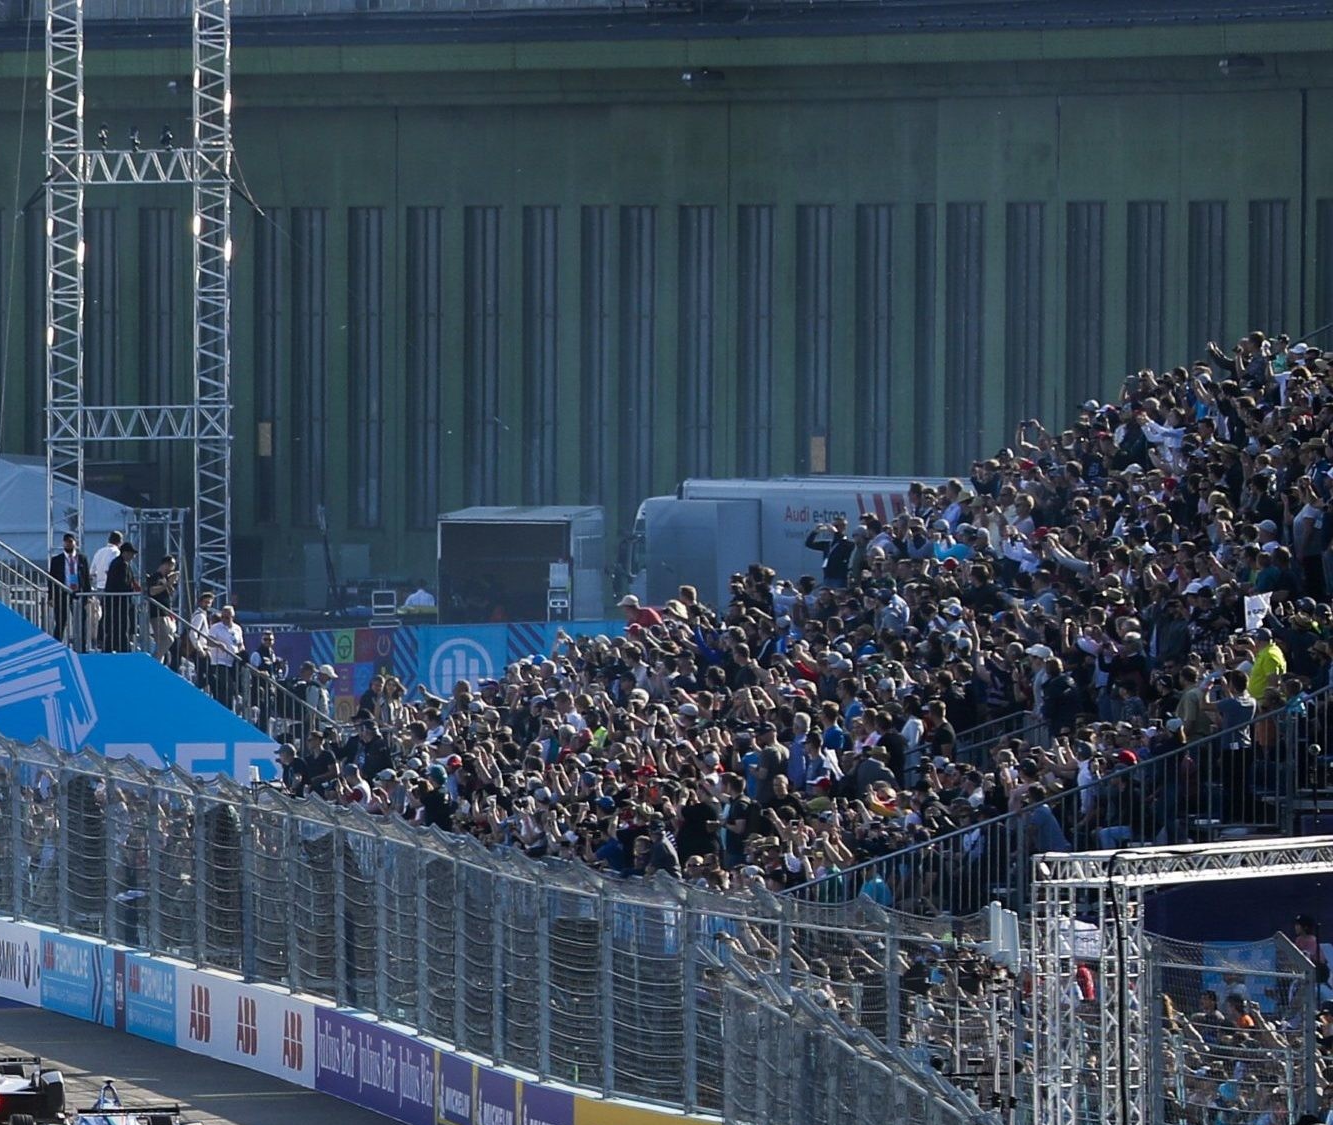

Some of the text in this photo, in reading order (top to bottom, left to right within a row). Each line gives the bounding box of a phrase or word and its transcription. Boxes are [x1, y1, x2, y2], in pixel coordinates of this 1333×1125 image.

[785, 505, 809, 522] Audi
[189, 983, 211, 1043] ABB
[237, 995, 258, 1056] ABB
[283, 1009, 303, 1071] ABB
[317, 1018, 340, 1077] Julius
[359, 1032, 381, 1093] Julius
[399, 1046, 420, 1108] Julius
[445, 1086, 471, 1118] MICHELIN
